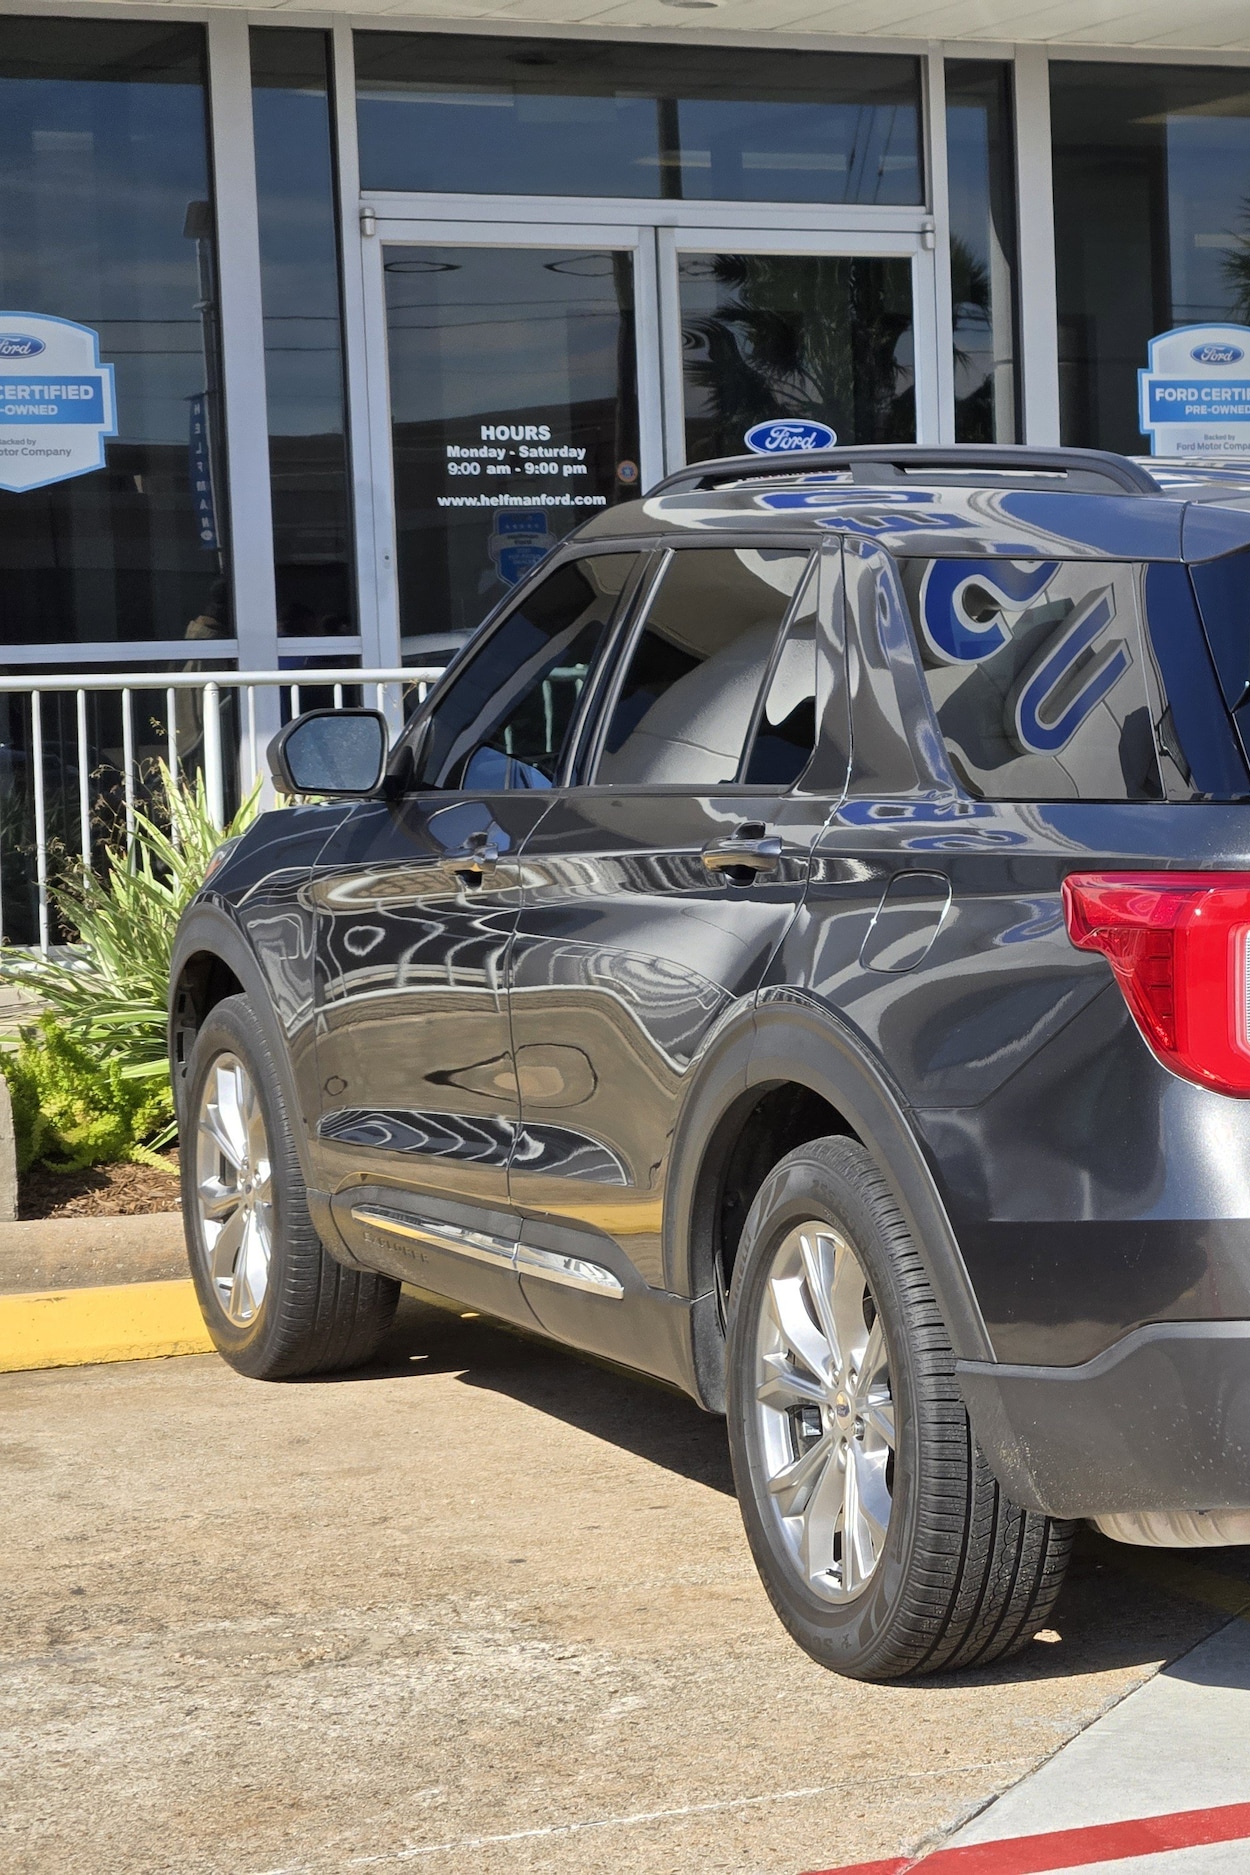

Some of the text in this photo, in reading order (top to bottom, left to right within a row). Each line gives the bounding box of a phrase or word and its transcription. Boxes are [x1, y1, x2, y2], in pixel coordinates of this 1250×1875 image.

[1200, 346, 1234, 362] Ford
[1155, 388, 1198, 401] FORD
[481, 425, 551, 441] HOURS
[764, 426, 818, 449] Ford
[1228, 434, 1236, 442] by
[26, 438, 37, 447] by
[1176, 442, 1198, 451] Ford
[1199, 442, 1222, 451] Motor
[21, 448, 72, 458] Company
[447, 445, 506, 460] Monday
[518, 445, 586, 460] Saturday
[447, 462, 481, 476] 9:00
[486, 464, 512, 475] am
[524, 462, 559, 475] 9:00
[562, 463, 588, 477] pm
[437, 494, 607, 507] www.helfmanford.com
